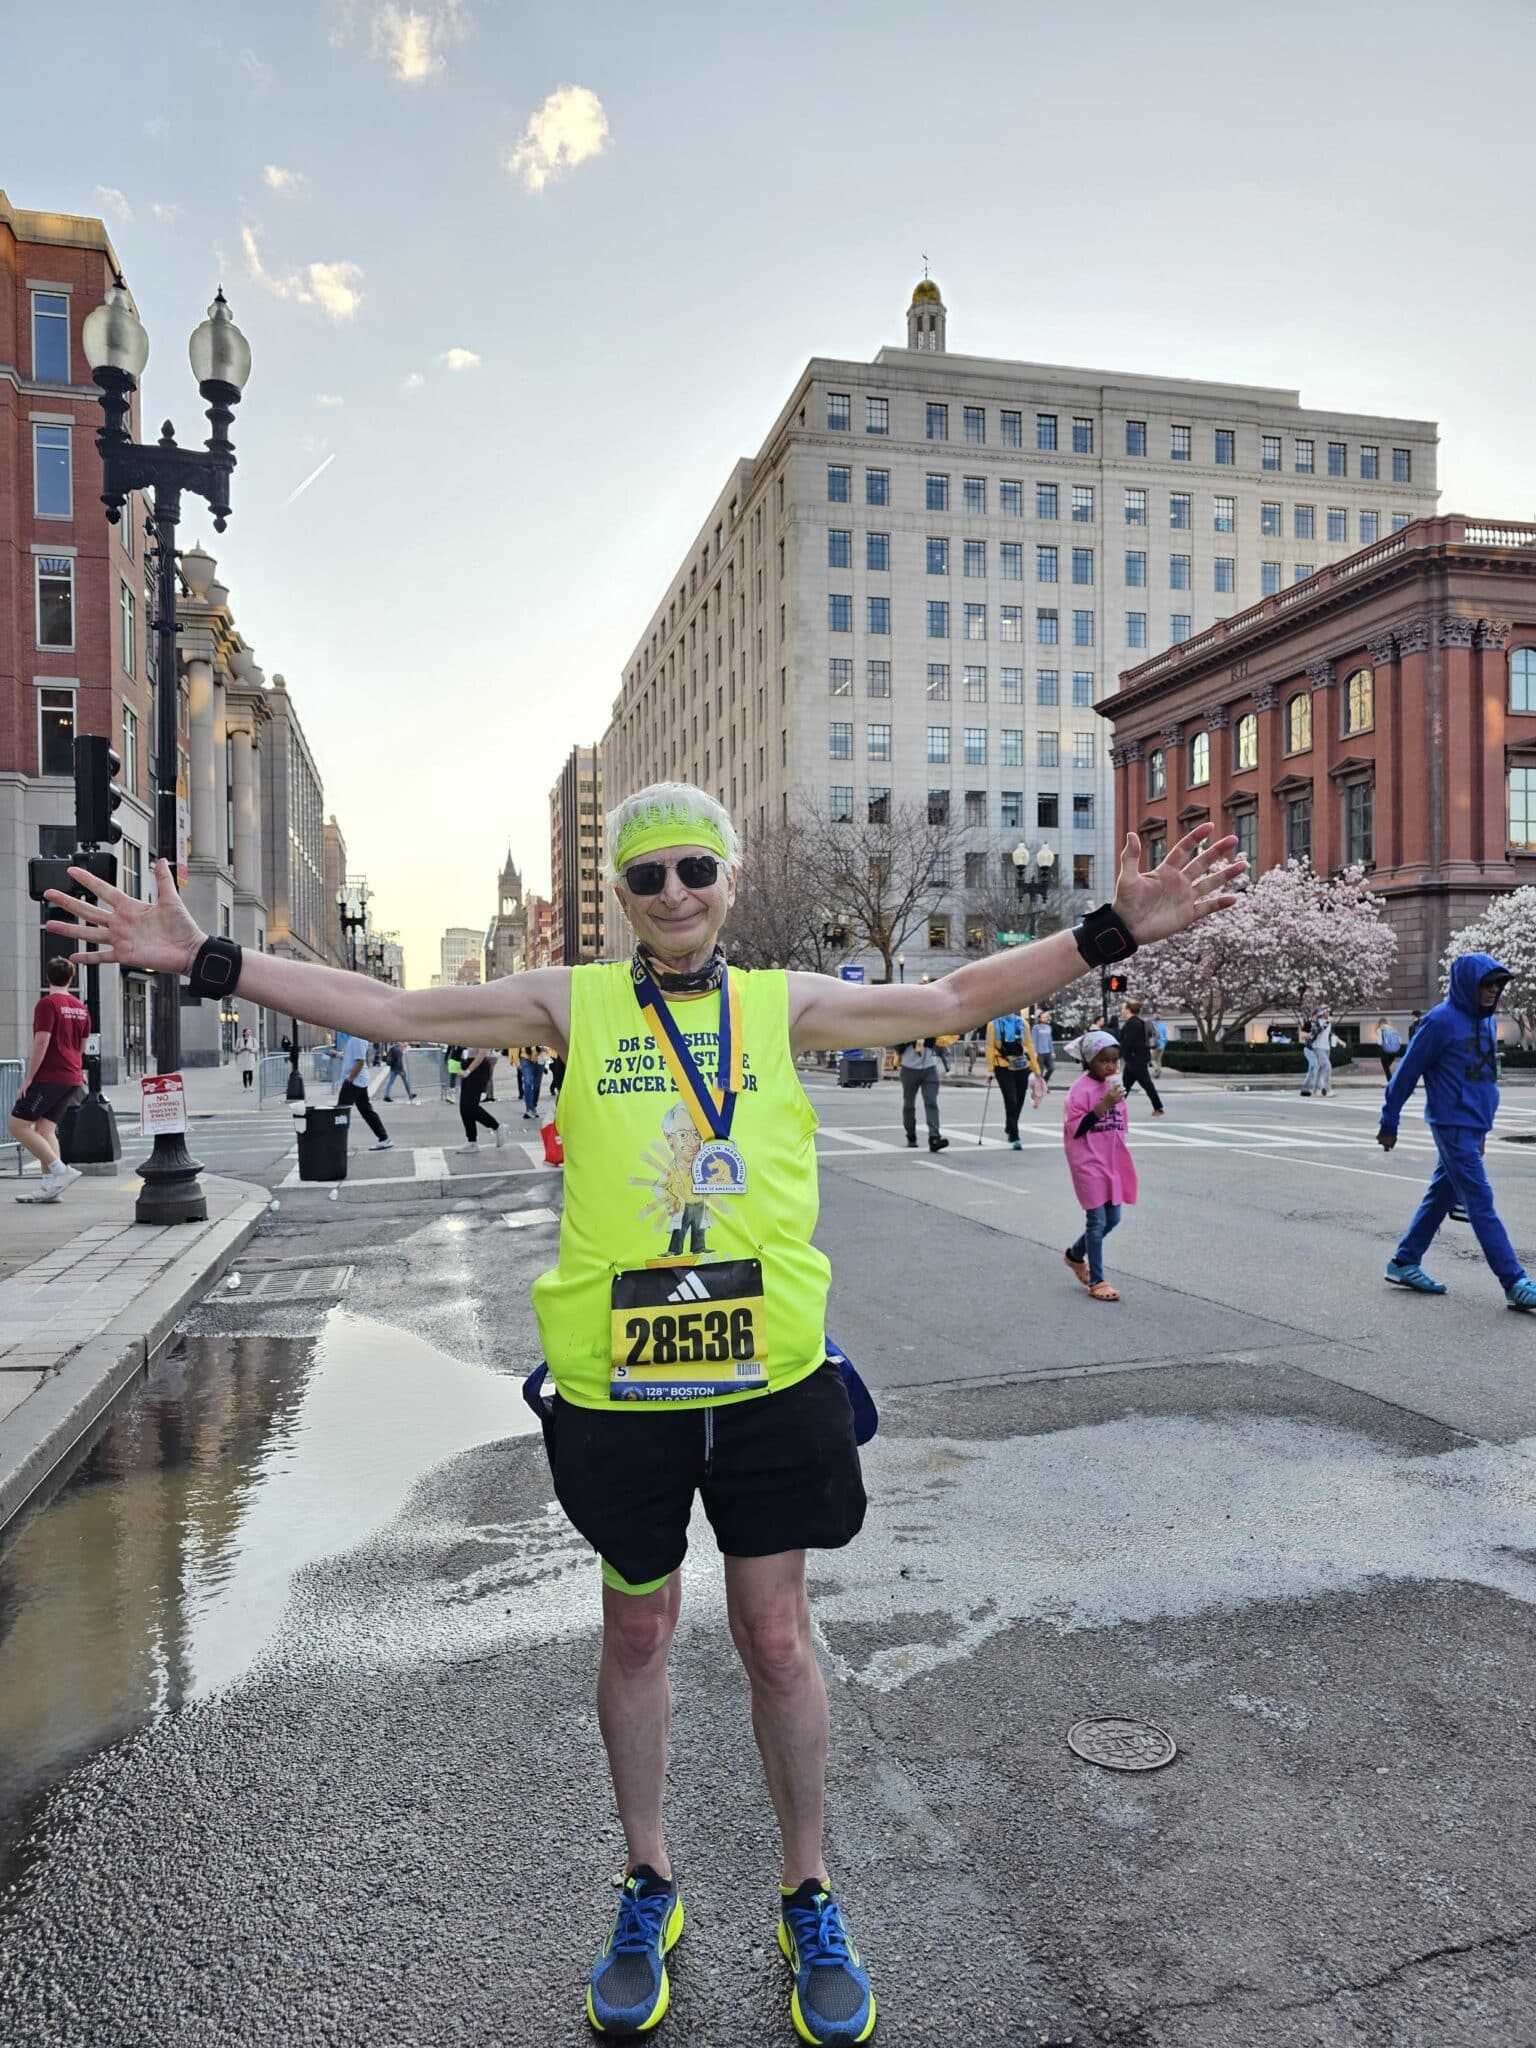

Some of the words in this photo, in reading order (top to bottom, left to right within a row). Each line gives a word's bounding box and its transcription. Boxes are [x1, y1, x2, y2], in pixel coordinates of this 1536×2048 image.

[618, 1036, 640, 1052] DR
[605, 1057, 622, 1074] 78
[625, 1055, 655, 1074] Y/O
[597, 1076, 667, 1096] CANCER
[625, 1308, 756, 1367] 28536
[617, 1366, 626, 1377] 5
[670, 1386, 715, 1396] BOSTON
